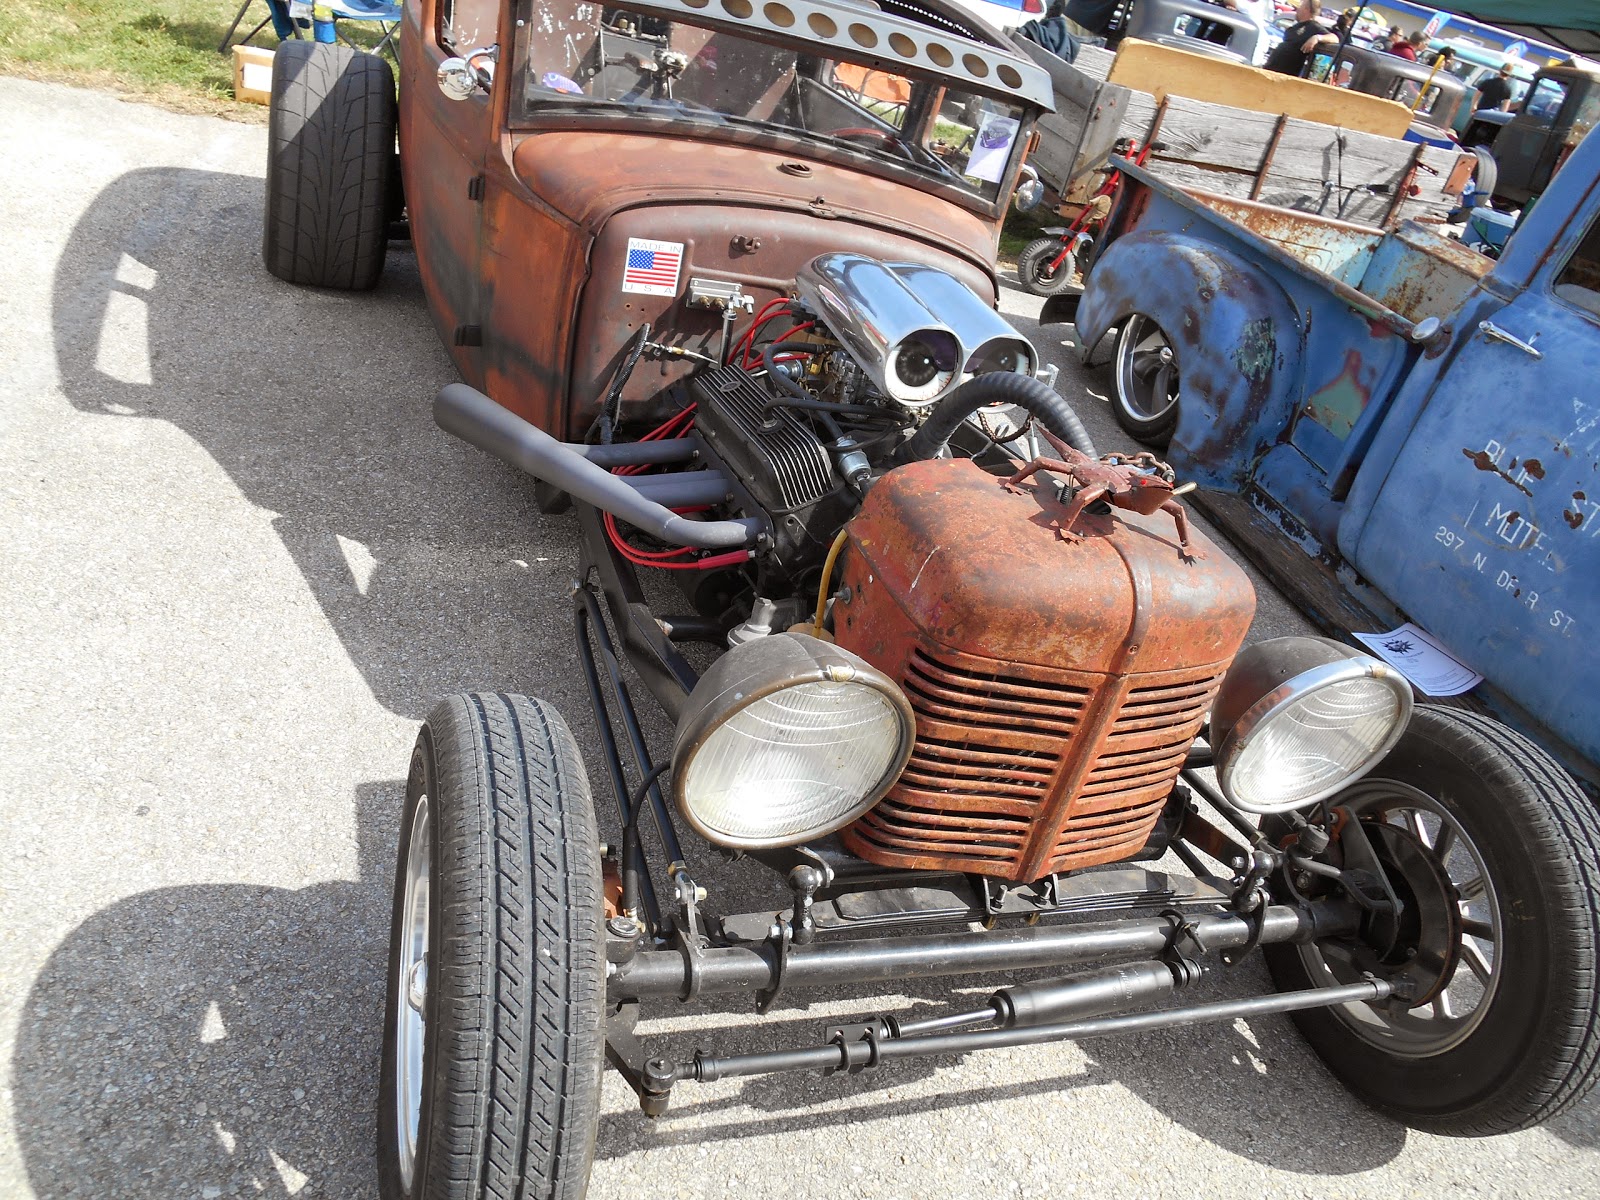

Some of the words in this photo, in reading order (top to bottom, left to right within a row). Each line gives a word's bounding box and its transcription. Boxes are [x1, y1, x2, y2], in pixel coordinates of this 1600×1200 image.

[630, 241, 665, 251] MADE
[1434, 525, 1465, 552] 297
[1472, 552, 1488, 574] N.
